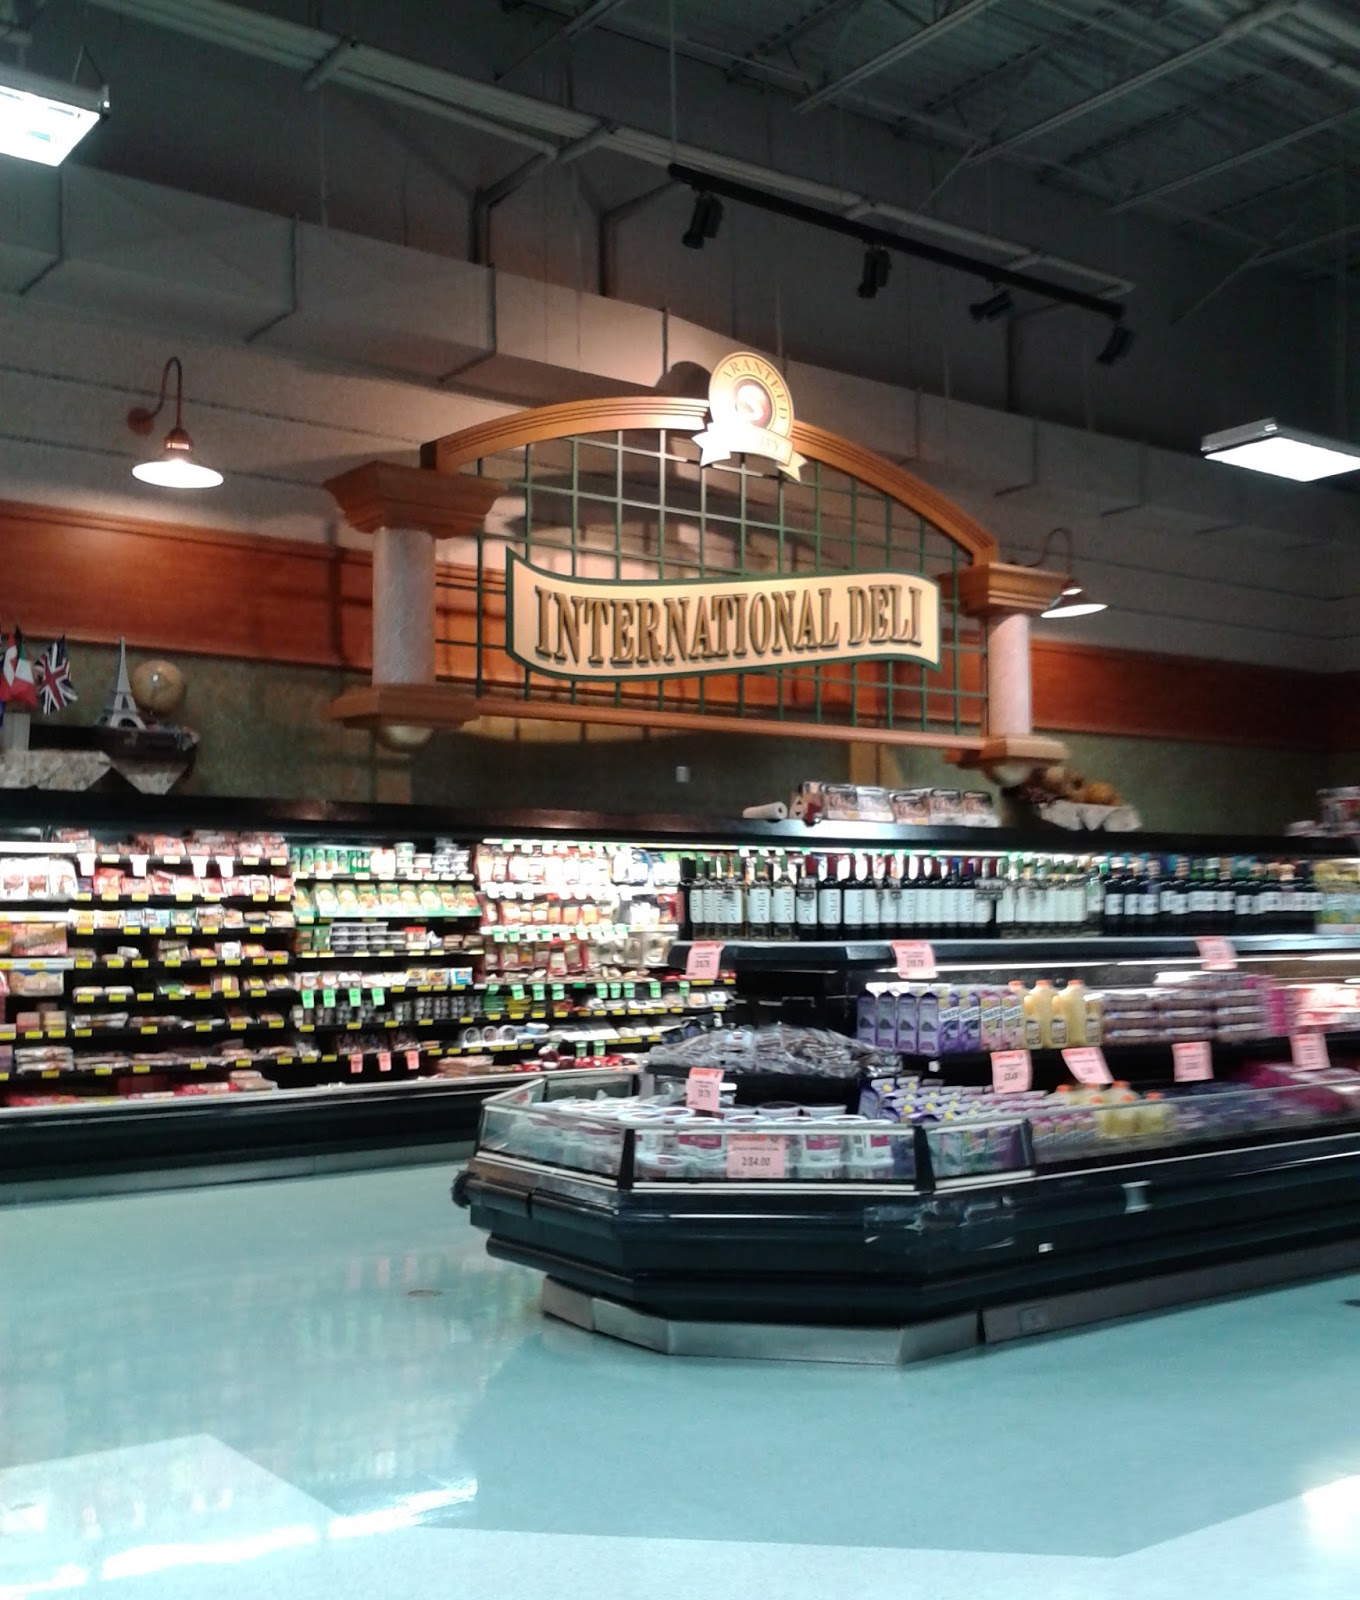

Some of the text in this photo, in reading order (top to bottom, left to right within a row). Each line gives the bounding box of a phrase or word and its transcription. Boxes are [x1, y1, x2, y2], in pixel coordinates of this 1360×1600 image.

[713, 358, 788, 421] ARANTEED
[534, 583, 923, 669] INTERNATIONAL DELI
